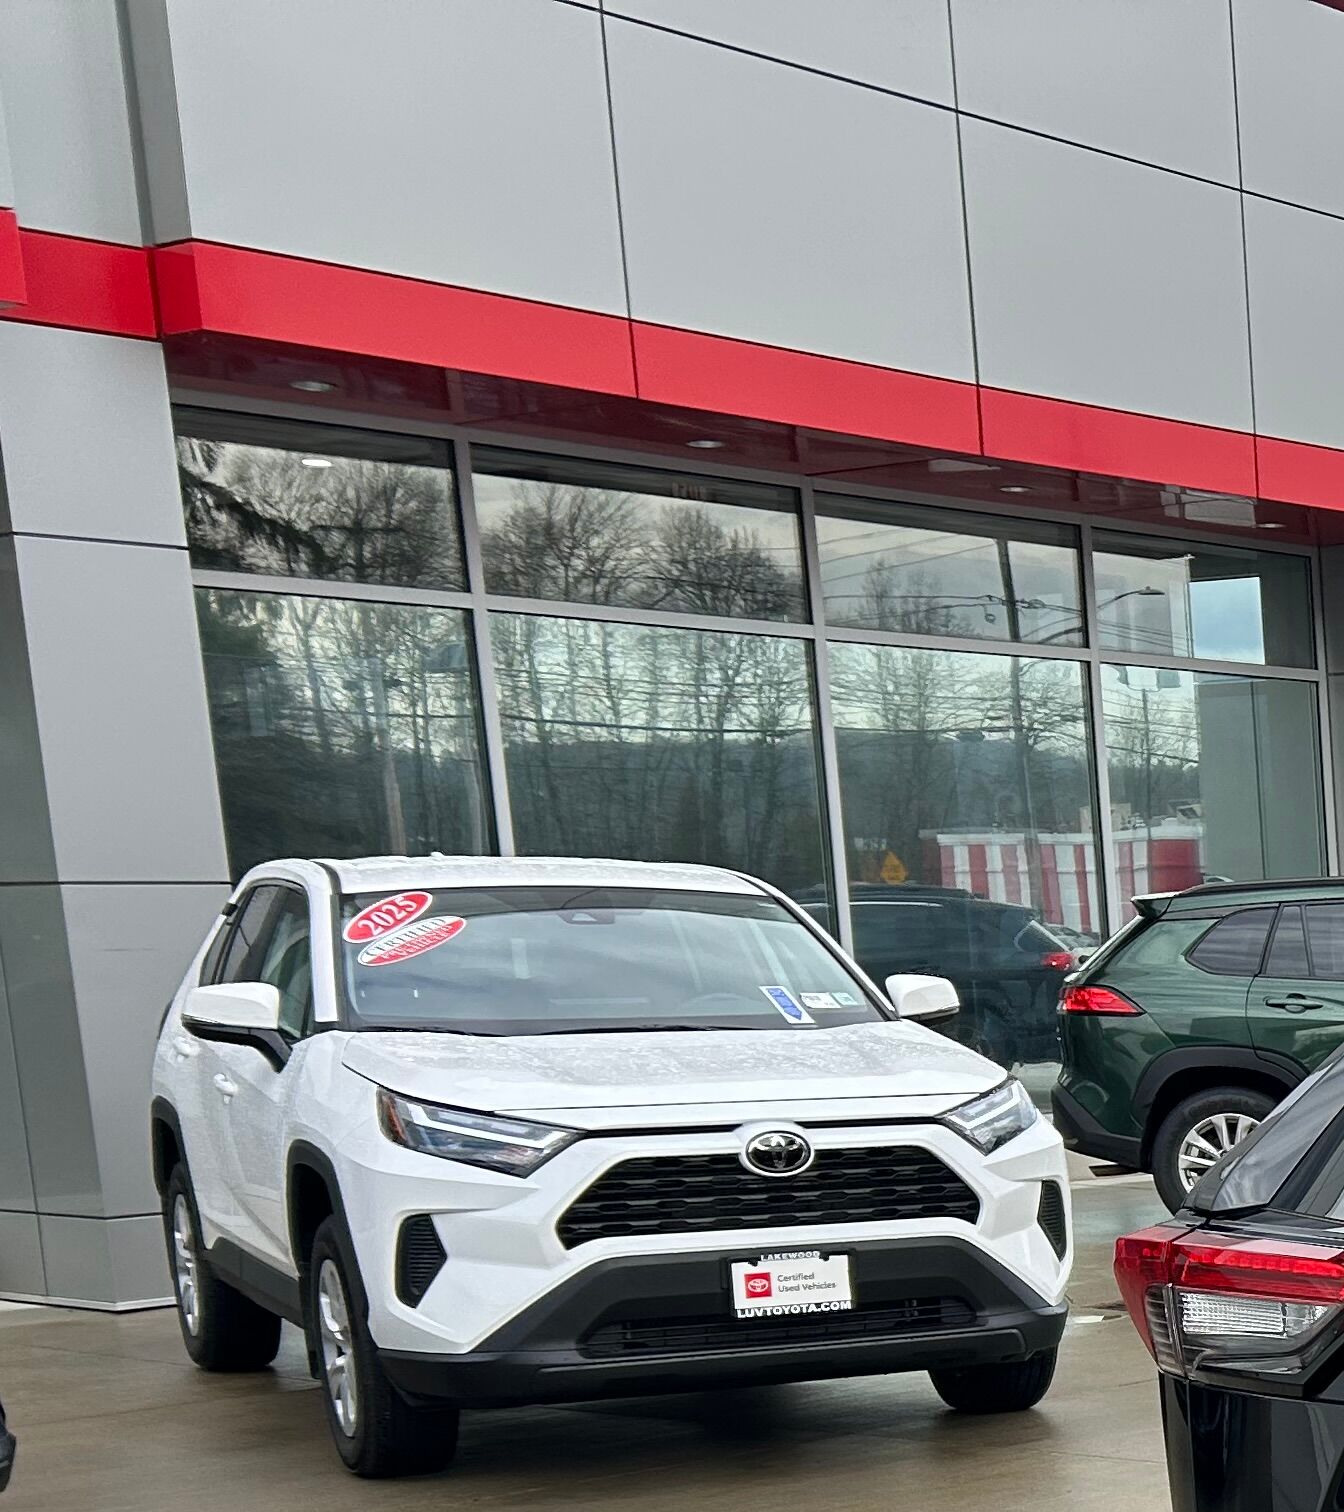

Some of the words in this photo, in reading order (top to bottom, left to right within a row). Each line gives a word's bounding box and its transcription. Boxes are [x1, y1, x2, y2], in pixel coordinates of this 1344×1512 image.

[357, 895, 417, 936] 2025
[760, 1250, 821, 1261] LAKEWOOD
[777, 1272, 815, 1282] Certified
[777, 1284, 800, 1293] Used
[802, 1281, 837, 1291] Vehicles
[737, 1300, 852, 1318] LUVTOYOTA.COM
